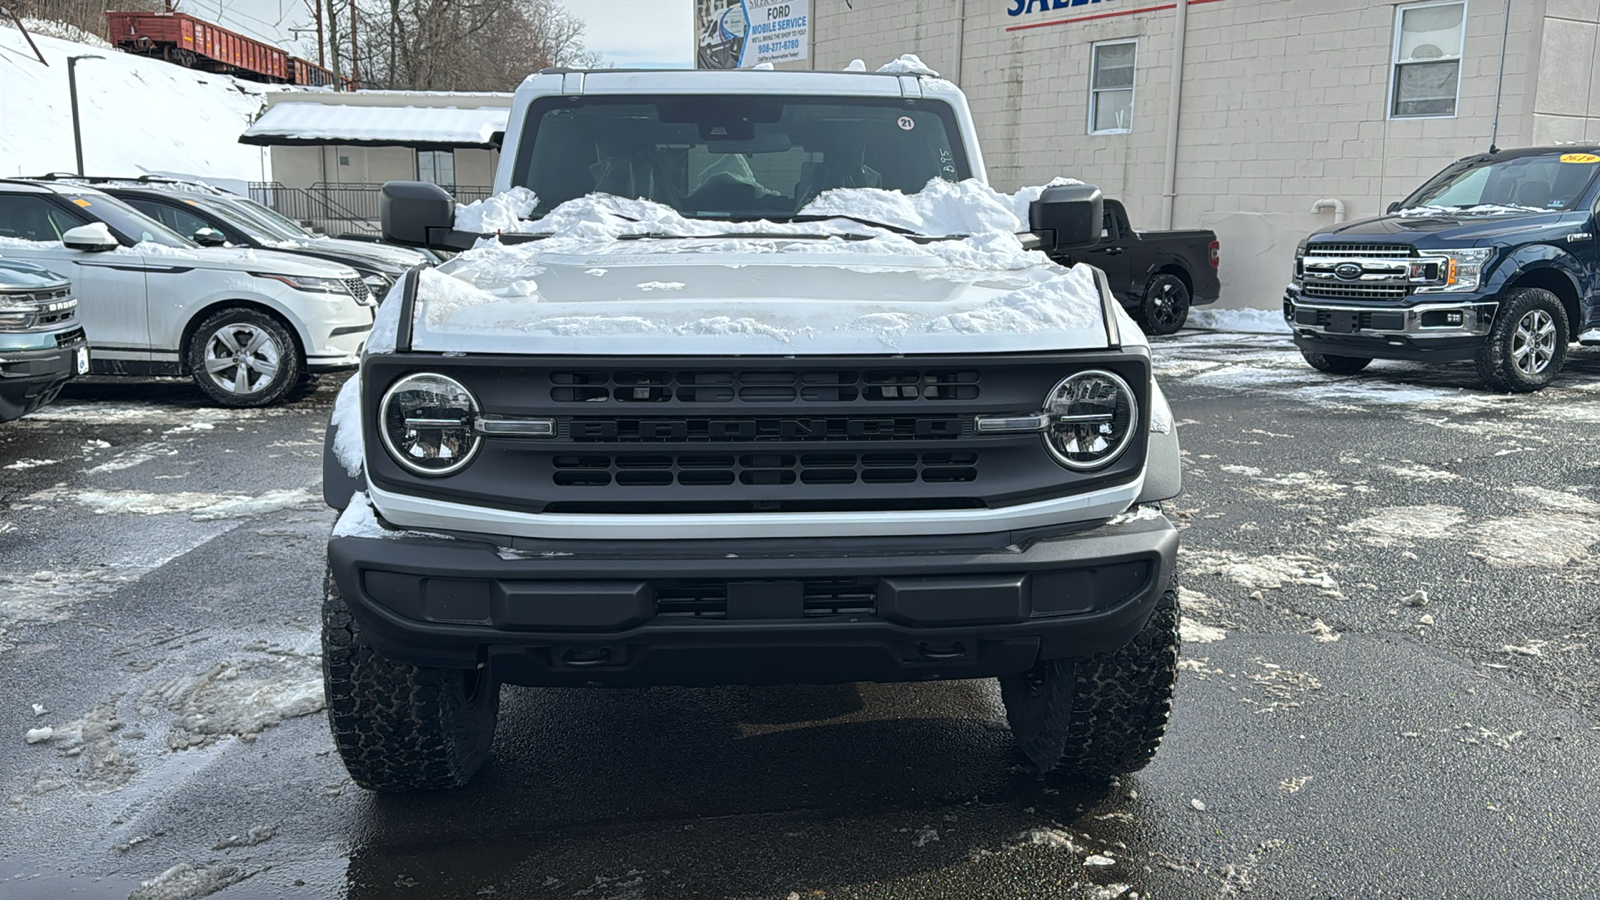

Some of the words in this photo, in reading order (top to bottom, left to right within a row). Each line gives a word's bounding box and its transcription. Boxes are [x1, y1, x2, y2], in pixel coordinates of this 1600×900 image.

[767, 5, 791, 20] FORD
[752, 21, 777, 34] MOBILE
[777, 16, 807, 31] SERVICE
[758, 39, 799, 54] 908-277-6780
[900, 118, 912, 128] 21
